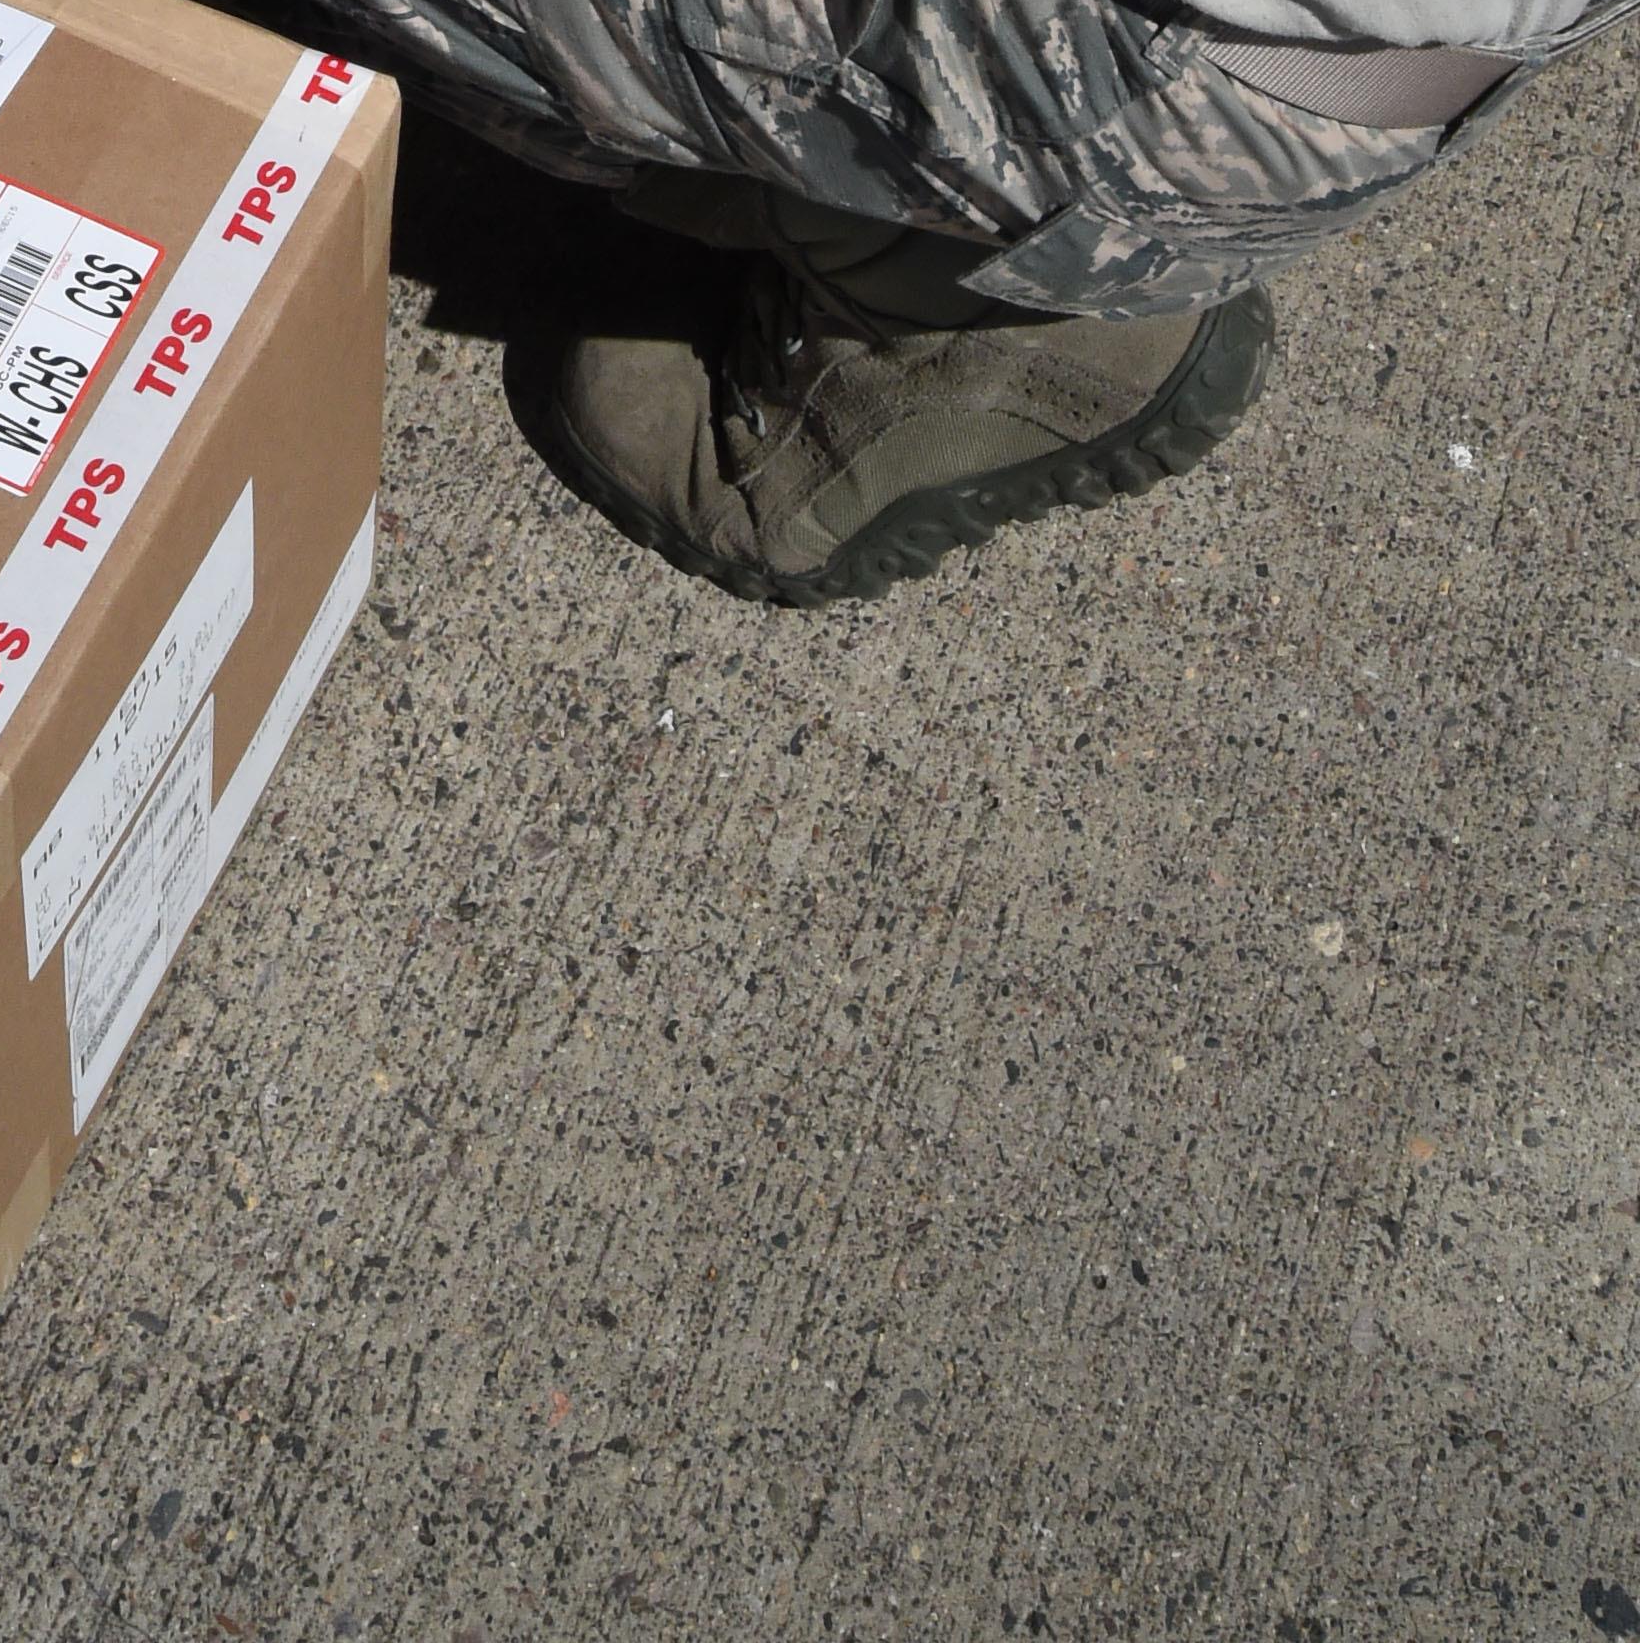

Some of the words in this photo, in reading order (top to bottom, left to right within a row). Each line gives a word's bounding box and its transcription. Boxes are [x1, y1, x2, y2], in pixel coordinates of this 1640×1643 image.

[300, 54, 354, 105] TP
[222, 161, 299, 246] TPS
[59, 249, 143, 322] CSS
[135, 308, 214, 398] TPS
[44, 458, 127, 552] TPS
[112, 630, 177, 757] 12/15
